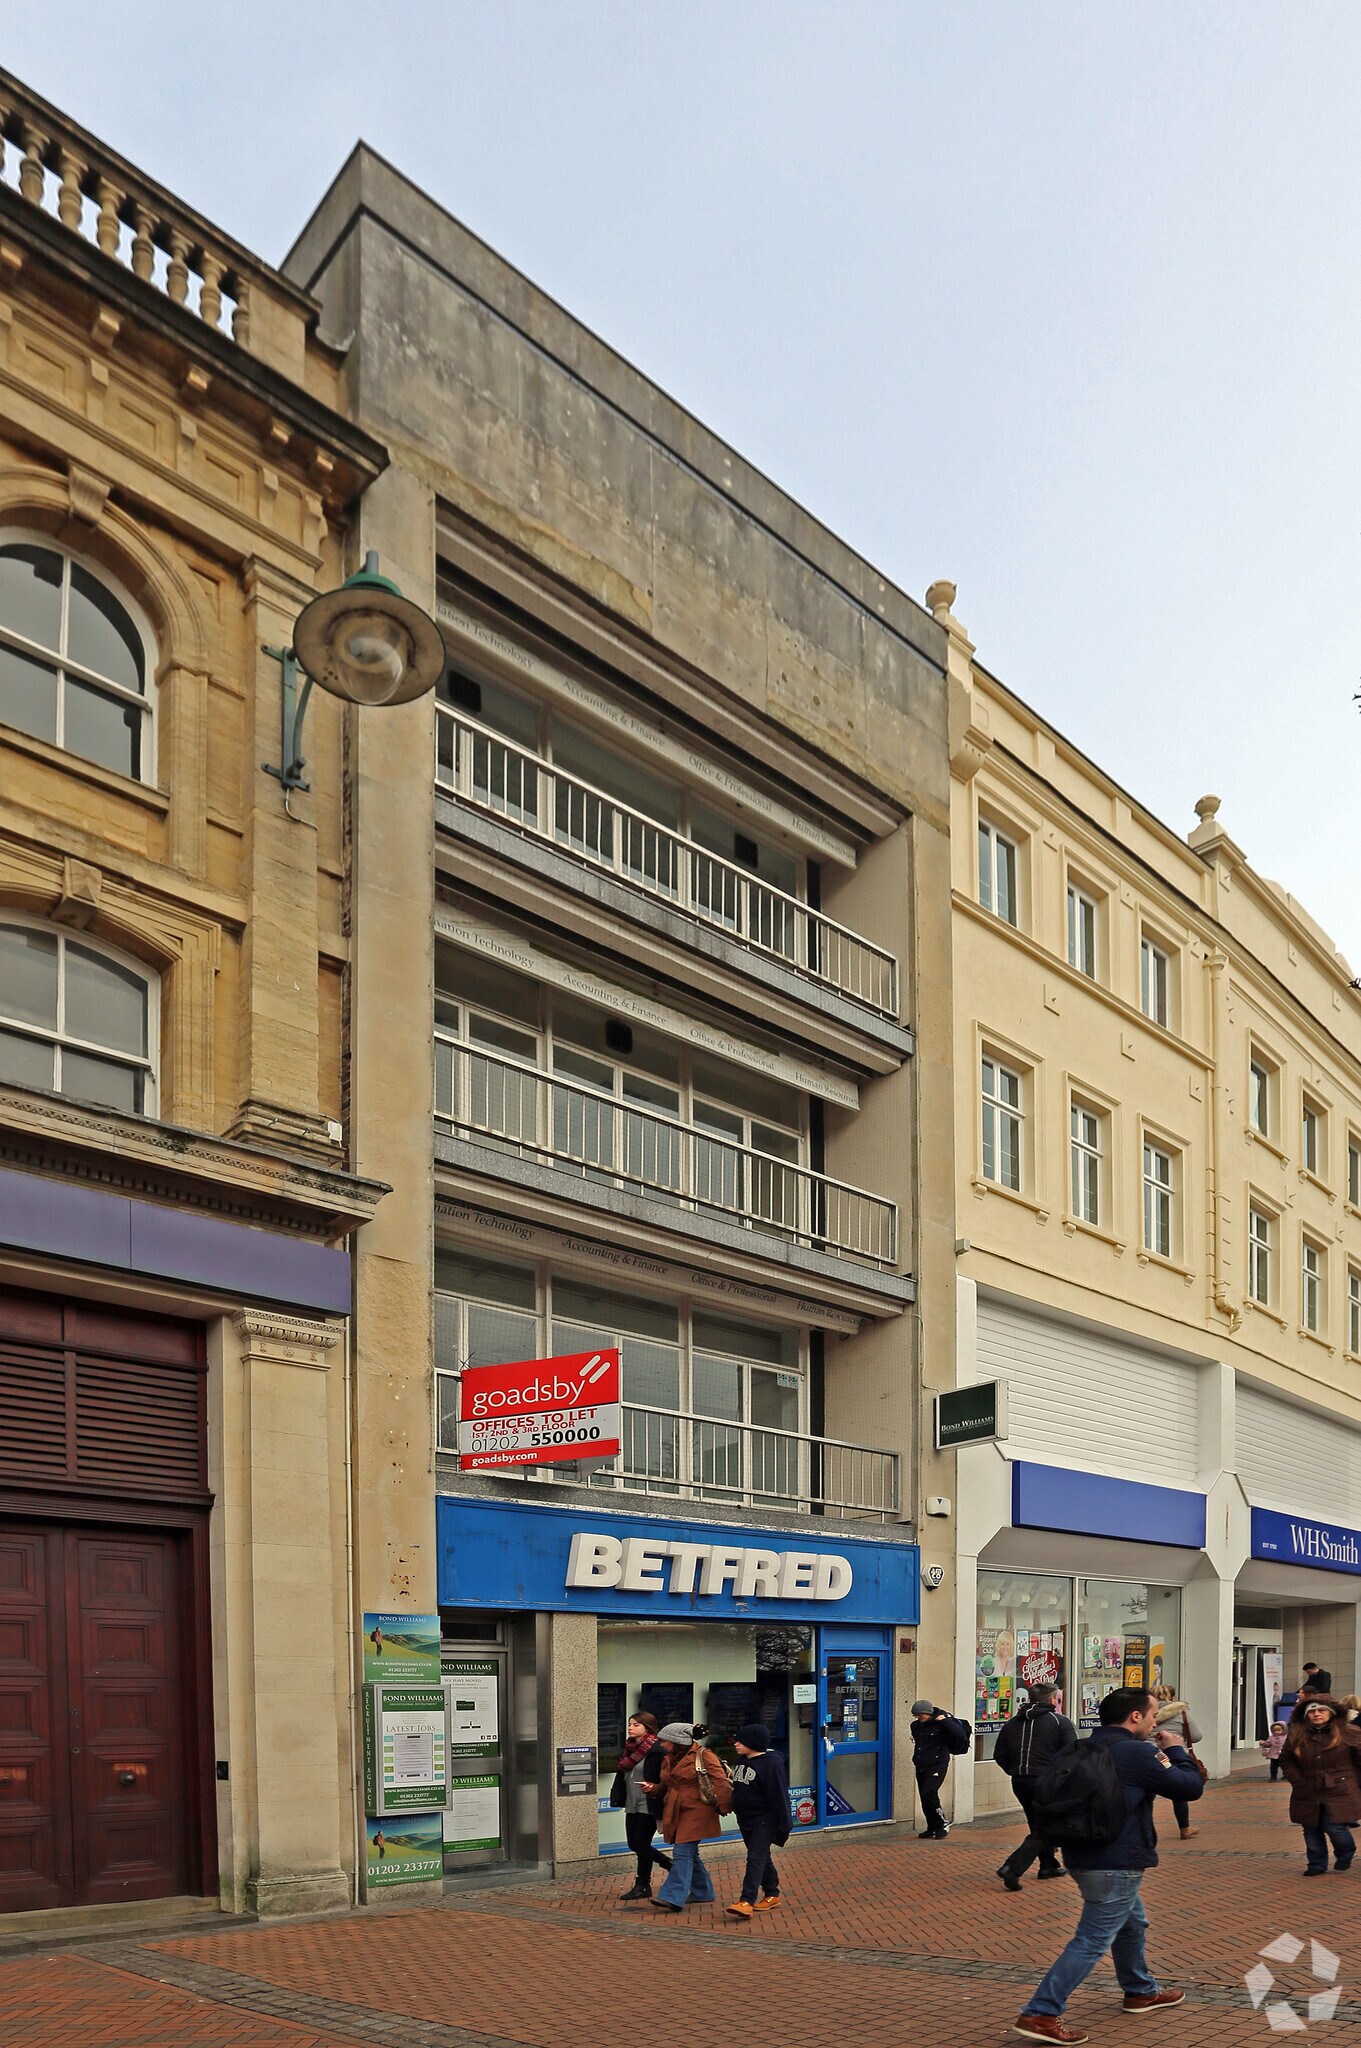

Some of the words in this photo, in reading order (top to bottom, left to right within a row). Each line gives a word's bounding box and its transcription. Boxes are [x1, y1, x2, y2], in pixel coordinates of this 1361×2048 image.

[473, 624, 534, 670] Technology
[563, 679, 618, 724] Accounting
[619, 714, 628, 727] &
[631, 719, 666, 746] Finance
[688, 753, 714, 777] Office
[715, 772, 722, 782] &
[724, 776, 772, 812] Professional
[792, 817, 820, 841] Human
[473, 933, 534, 969] Technology
[564, 973, 619, 1006] Accounting
[621, 999, 629, 1009] &
[632, 1002, 667, 1025] Finance
[690, 1028, 716, 1046] Office
[717, 1040, 725, 1049] &
[727, 1043, 775, 1071] Professional
[795, 1072, 823, 1092] Human
[473, 1212, 535, 1240] Technology
[562, 1237, 620, 1265] Accounting
[621, 1256, 630, 1265] &
[632, 1257, 669, 1275] Finance
[691, 1273, 717, 1289] Office
[718, 1281, 726, 1290] &
[728, 1283, 778, 1304] Professional
[797, 1301, 825, 1316] Human
[826, 1309, 860, 1325] Resources
[472, 1375, 586, 1416] goadsby
[472, 1416, 535, 1432] OFFICES
[542, 1413, 564, 1425] TO
[569, 1408, 598, 1421] LET
[512, 1427, 519, 1435] &
[522, 1426, 539, 1434] 3RD
[541, 1421, 575, 1431] FLOOR
[941, 1423, 960, 1431] BOND
[962, 1416, 994, 1426] WILLIAMS
[472, 1436, 519, 1453] 01202
[531, 1426, 601, 1447] 550000
[472, 1451, 538, 1467] goadsby.com
[1290, 1524, 1360, 1565] WHSmith
[565, 1532, 853, 1601] BETFRED
[836, 1686, 869, 1694] BETFRED
[368, 1864, 400, 1876] 01202
[404, 1860, 440, 1872] 233777
